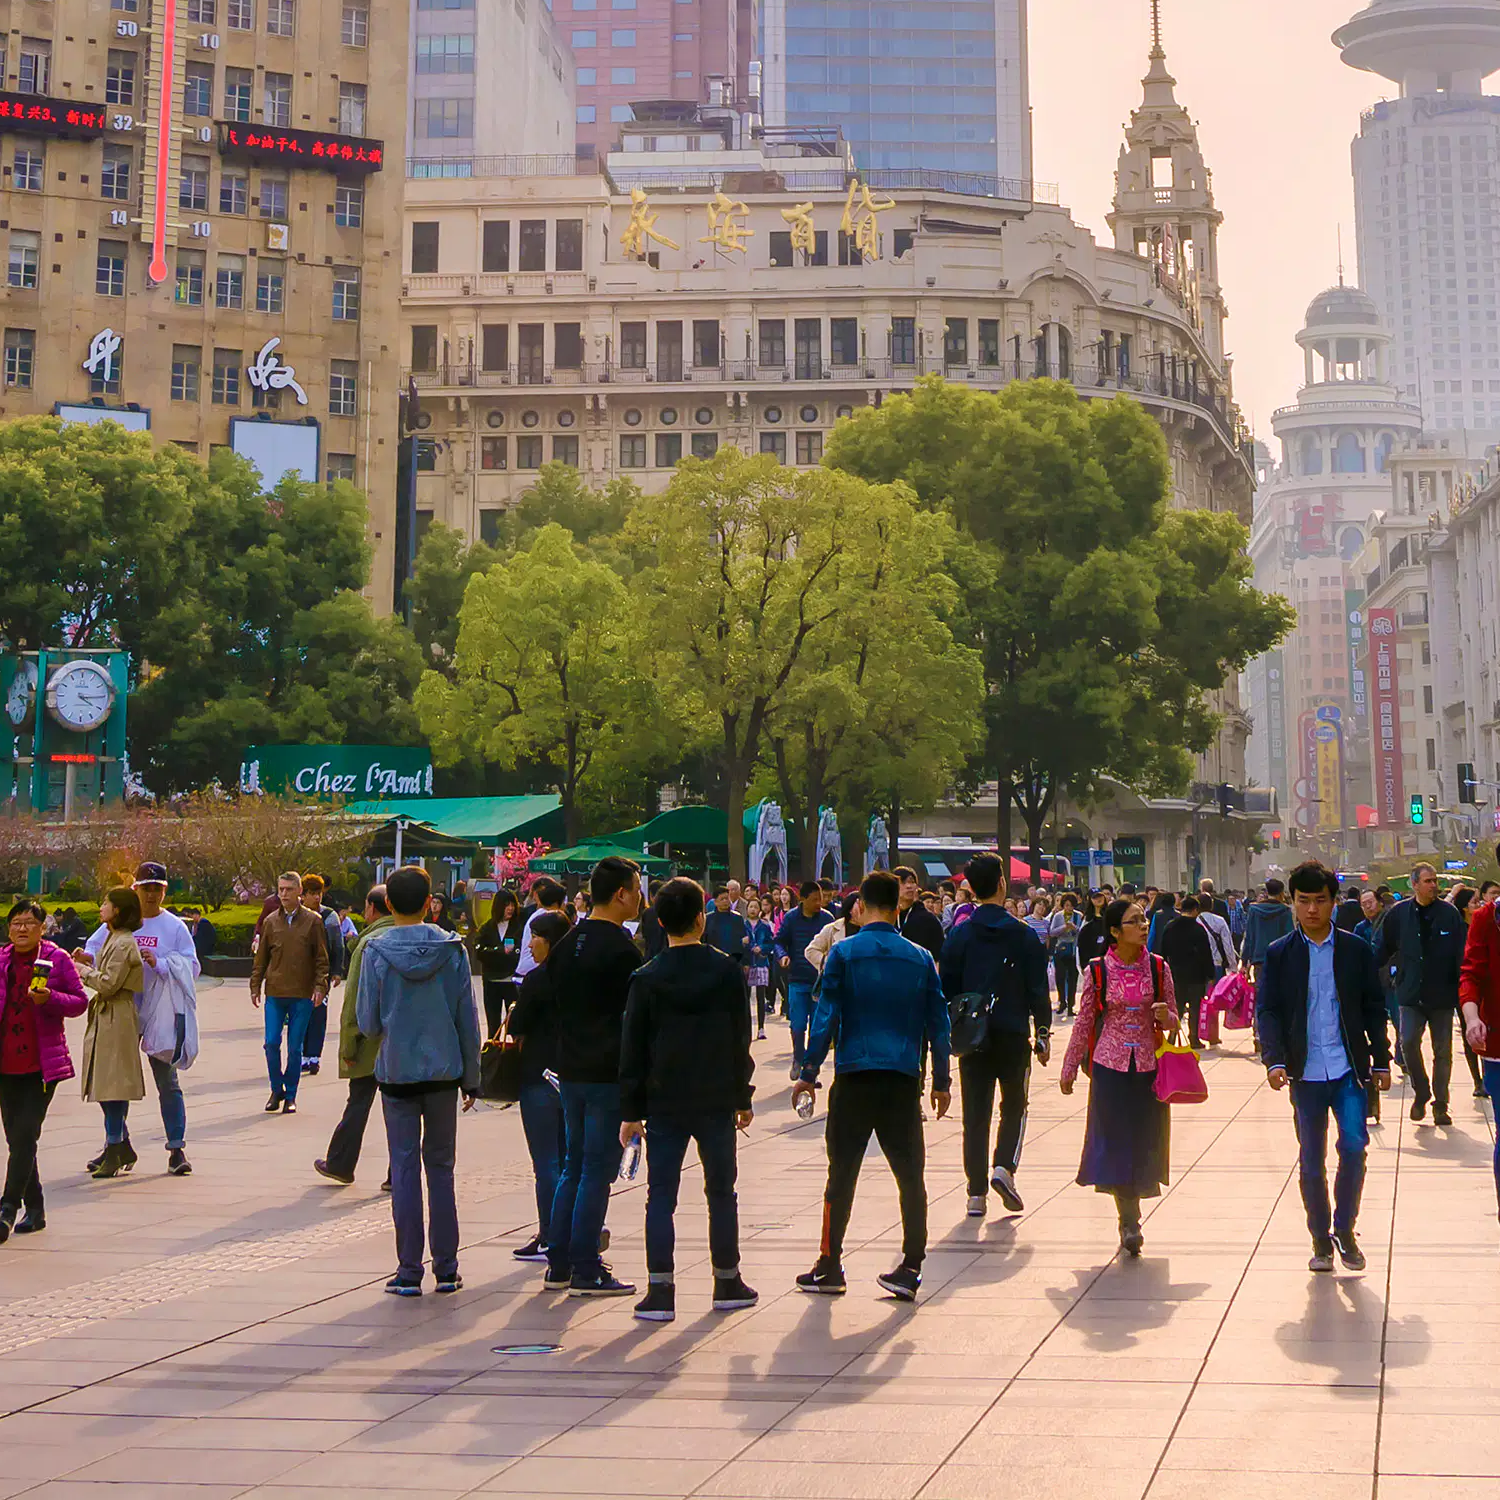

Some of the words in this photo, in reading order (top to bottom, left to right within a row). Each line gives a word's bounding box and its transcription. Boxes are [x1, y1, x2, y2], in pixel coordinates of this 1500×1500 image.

[117, 20, 138, 37] 50
[200, 34, 219, 50] 10
[113, 114, 133, 131] 32
[110, 209, 128, 226] 14
[295, 762, 357, 793] Chez
